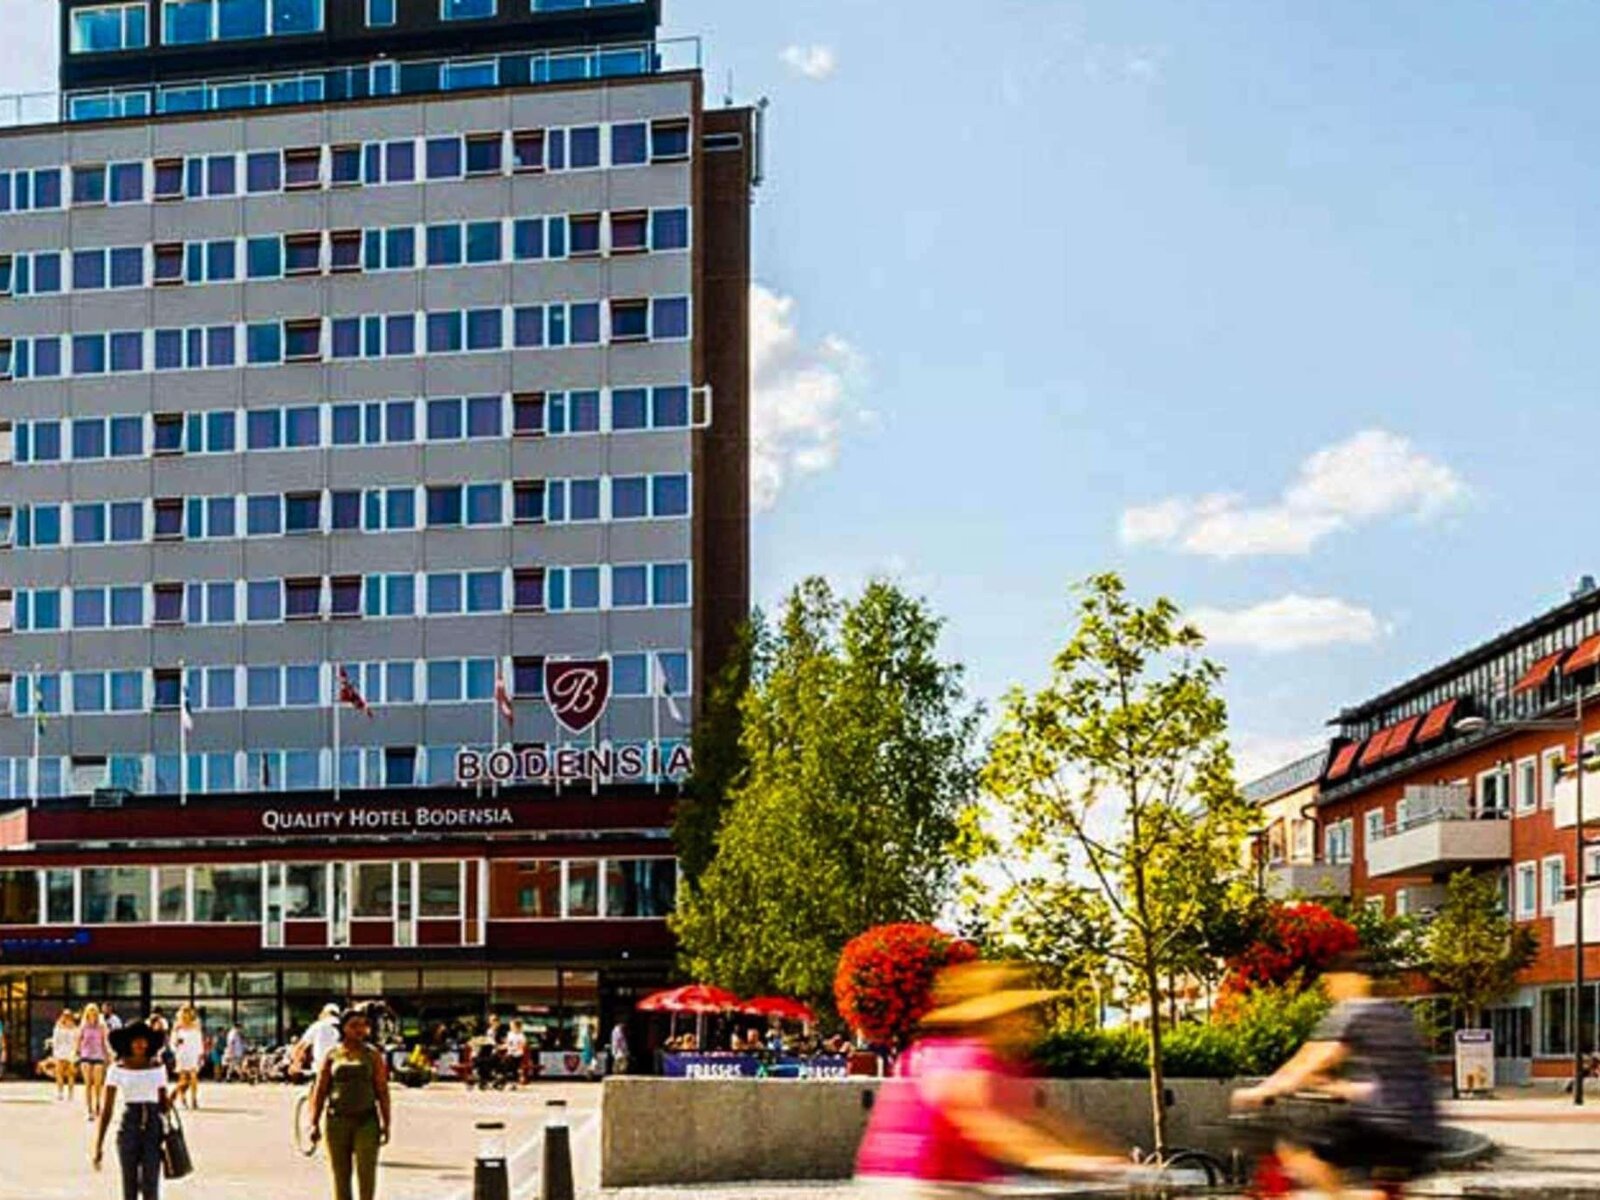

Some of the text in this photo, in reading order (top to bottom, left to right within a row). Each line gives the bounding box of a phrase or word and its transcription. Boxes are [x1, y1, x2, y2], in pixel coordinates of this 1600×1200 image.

[553, 667, 599, 714] B
[457, 745, 694, 782] BODENSIA
[262, 807, 513, 831] QUALITY HOTEL BODENSIA
